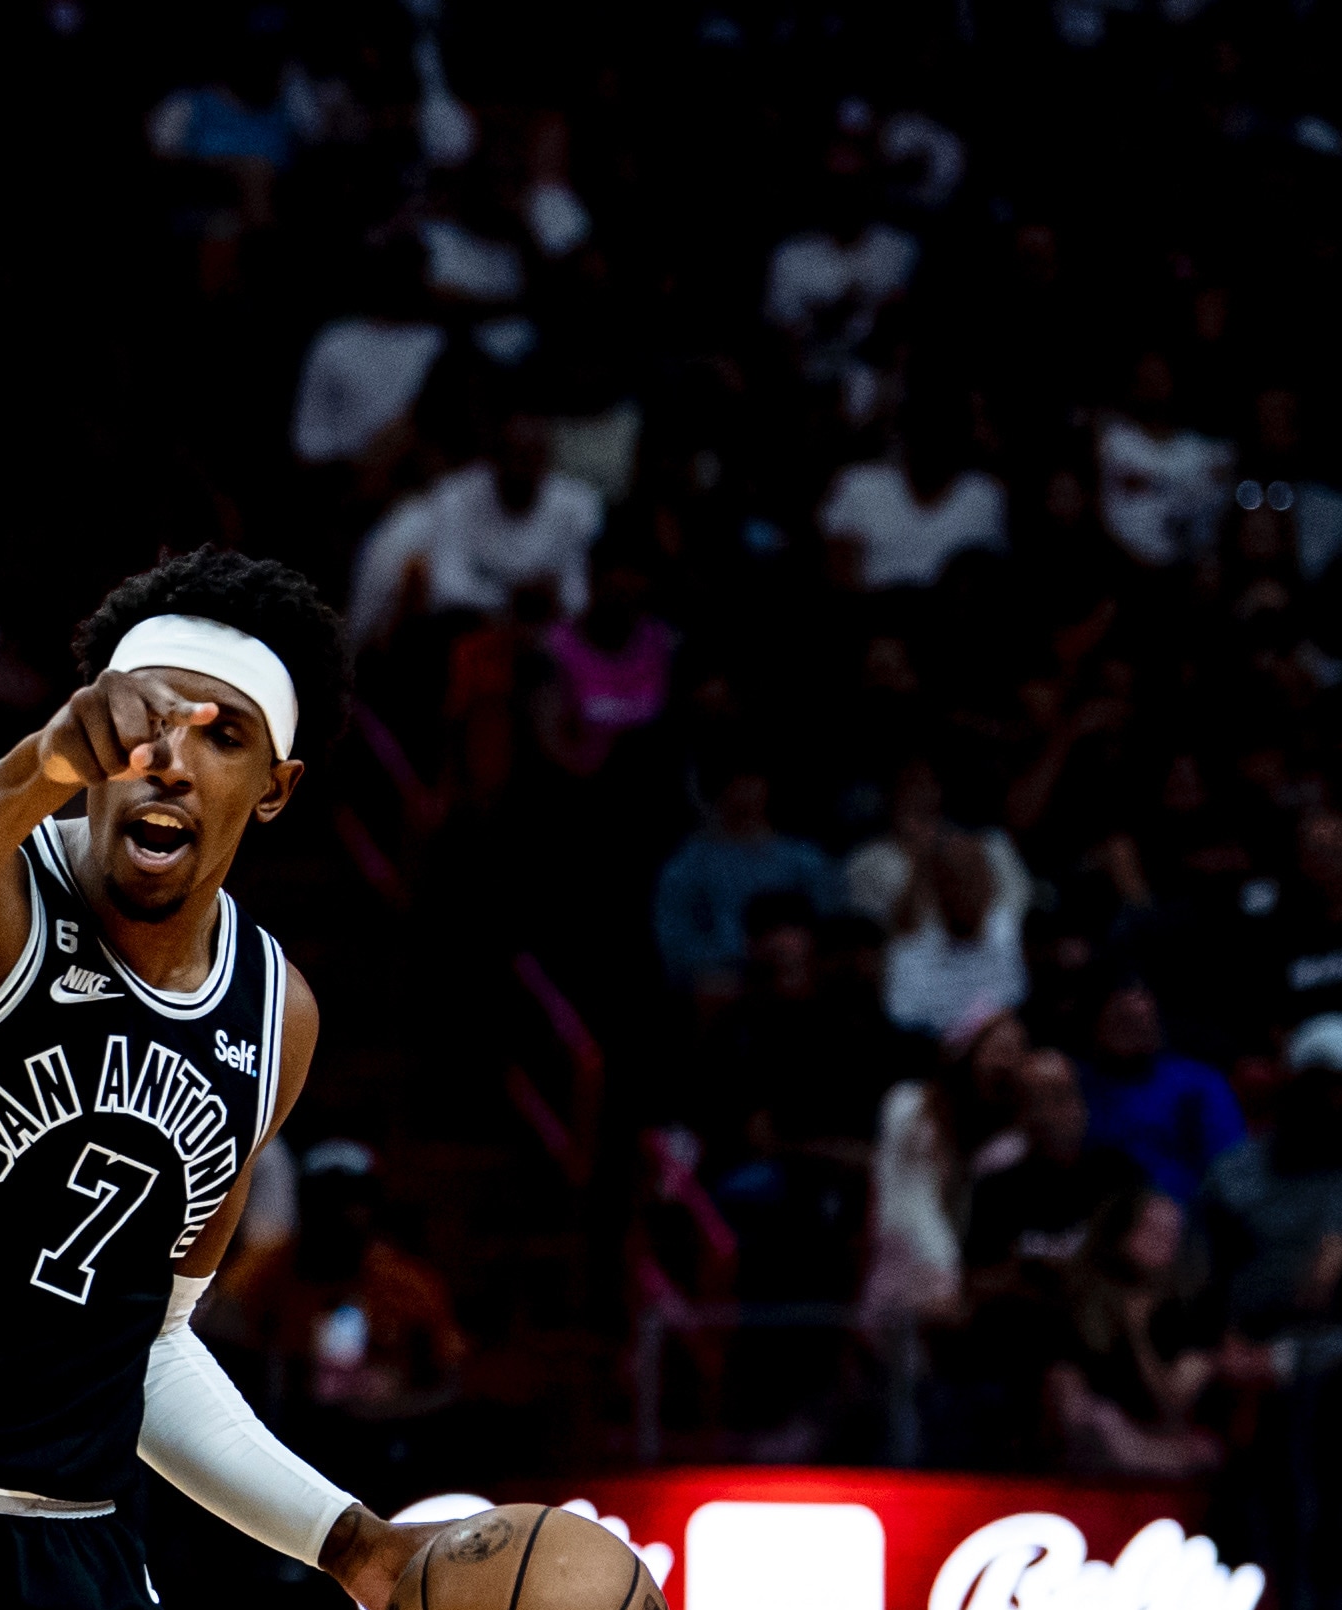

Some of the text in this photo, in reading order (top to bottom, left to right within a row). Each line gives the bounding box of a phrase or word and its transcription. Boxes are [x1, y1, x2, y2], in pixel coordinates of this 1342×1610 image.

[55, 918, 79, 954] 6
[61, 964, 111, 997] NIKE
[30, 1142, 160, 1305] 7
